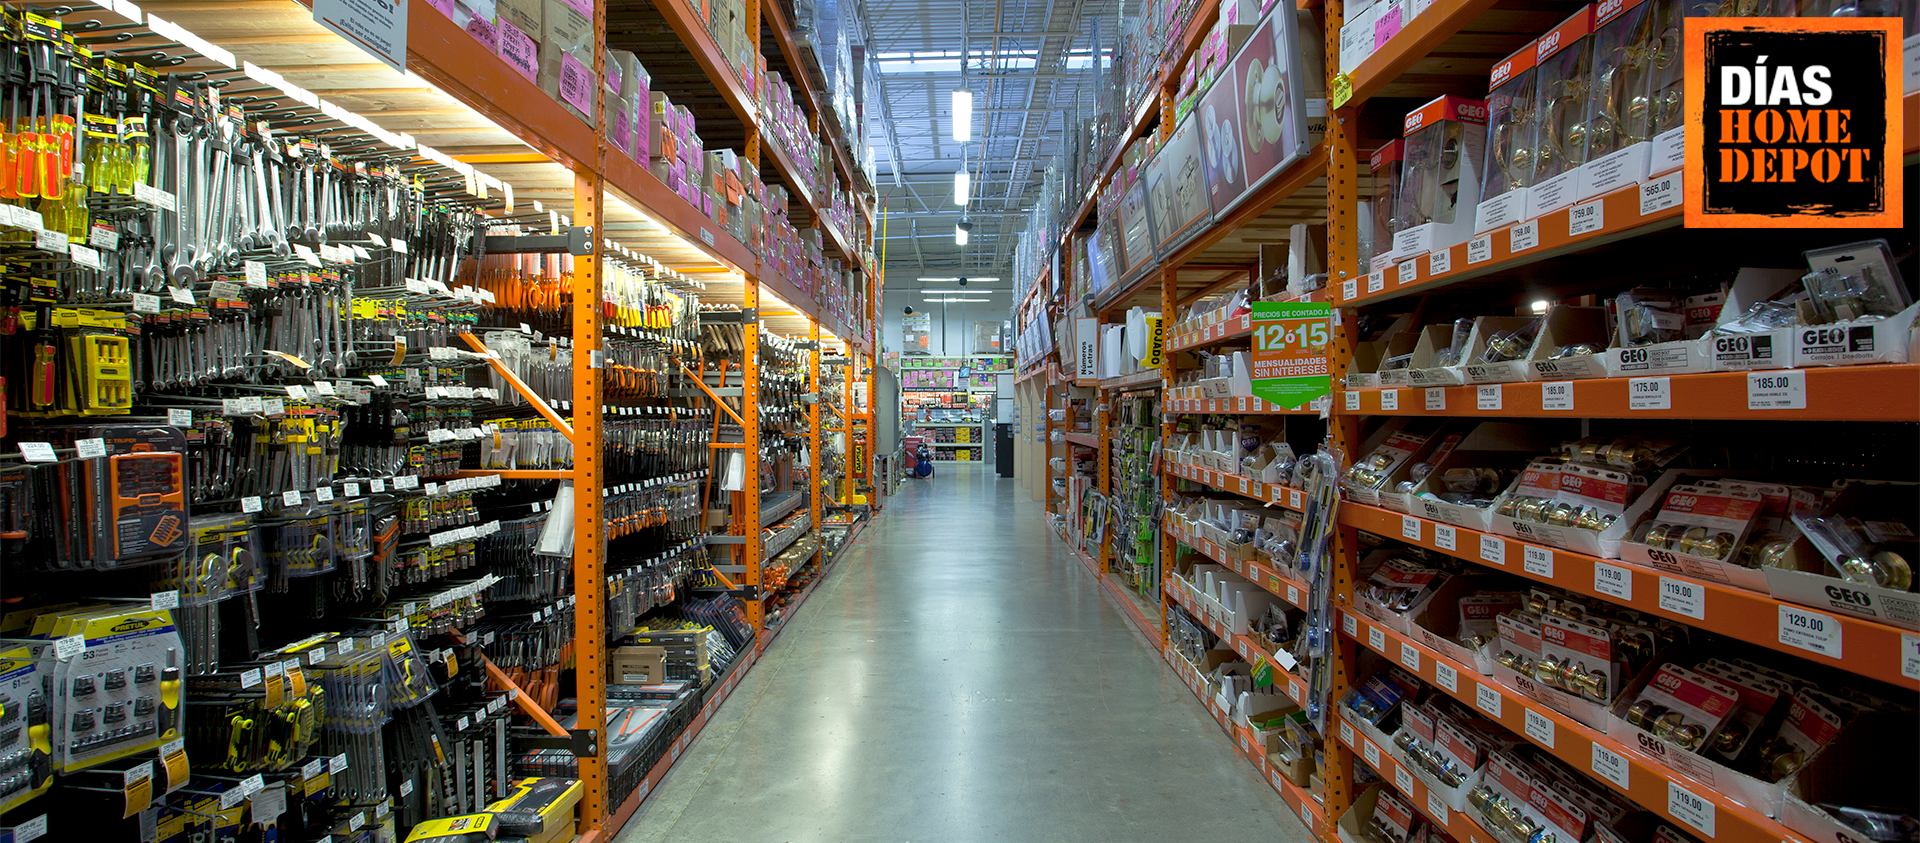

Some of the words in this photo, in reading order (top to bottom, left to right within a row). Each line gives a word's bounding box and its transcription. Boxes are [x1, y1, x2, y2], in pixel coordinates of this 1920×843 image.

[1597, 0, 1623, 18] GEO
[1538, 31, 1560, 55] GEO
[1491, 61, 1512, 82] GEO
[1458, 104, 1485, 118] GEO
[1406, 112, 1424, 129] GEO
[1371, 153, 1382, 167] GEO
[1254, 310, 1280, 318] PRECIOS
[1690, 308, 1710, 319] GEO
[1152, 319, 1163, 365] MOJADO
[1254, 324, 1286, 350] 12
[1285, 329, 1296, 344] ó
[1295, 322, 1329, 348] 15
[1802, 328, 1845, 346] GEO
[1716, 336, 1748, 352] GEO
[1254, 357, 1327, 368] MENSUALIDADES
[1620, 348, 1648, 364] GEO
[1254, 368, 1270, 378] SIN
[1272, 365, 1328, 376] INTERESES
[1409, 370, 1424, 379] GEO
[1467, 366, 1486, 376] GEO
[1535, 362, 1558, 373] GEO
[1380, 370, 1391, 380] GEO
[1754, 376, 1789, 388] $185.00
[1524, 472, 1539, 482] GEO
[1562, 475, 1582, 487] GEO
[1669, 494, 1697, 506] GEO
[1424, 503, 1438, 514] GEO
[1512, 521, 1532, 534] GEO
[1648, 548, 1677, 564] GEO
[1824, 585, 1871, 606] GEO
[1467, 605, 1489, 614] GEO
[114, 622, 144, 632] PRETUL
[1786, 613, 1824, 632] $129.00
[1500, 625, 1515, 639] GEO
[1544, 626, 1565, 640] GEO
[82, 651, 95, 660] 53
[12, 679, 21, 689] 61
[1515, 676, 1534, 691] GEO
[1656, 673, 1682, 689] GEO
[1790, 703, 1806, 721] GEO
[1438, 730, 1451, 743] GEO
[1637, 732, 1665, 755] GEO
[1488, 760, 1502, 776] GEO
[1378, 798, 1389, 811] GEO
[1530, 789, 1548, 810] GEO
